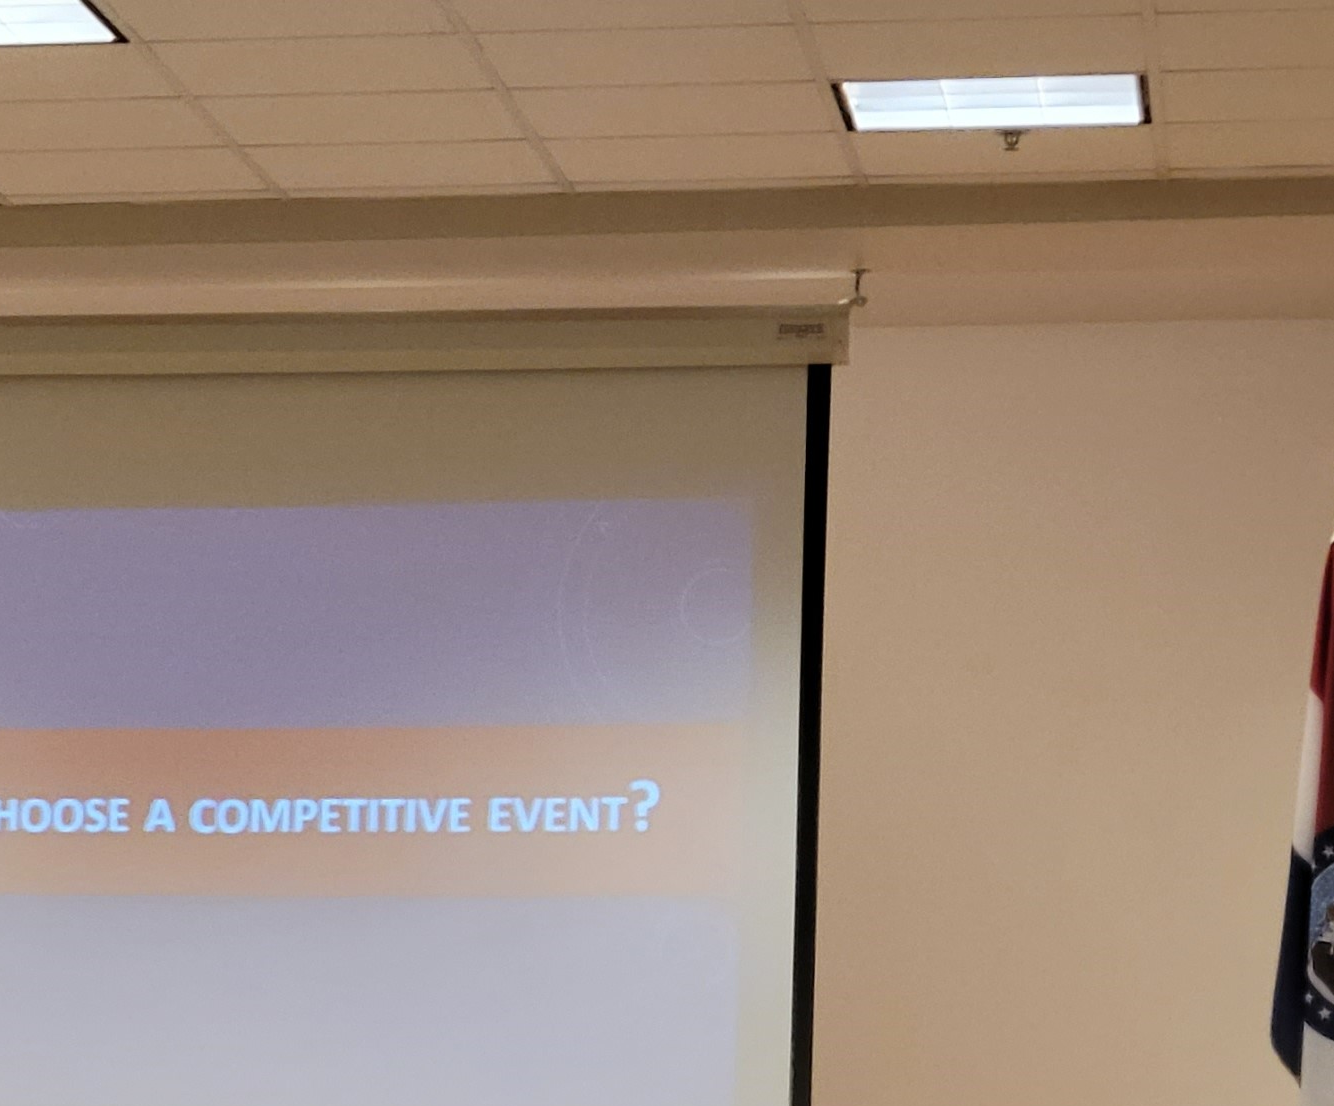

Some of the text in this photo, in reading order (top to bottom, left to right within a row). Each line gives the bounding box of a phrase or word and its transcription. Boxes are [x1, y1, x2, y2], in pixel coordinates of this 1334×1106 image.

[142, 797, 177, 834] A
[188, 797, 472, 835] COMPETITIVE
[486, 778, 661, 834] EVENT?
